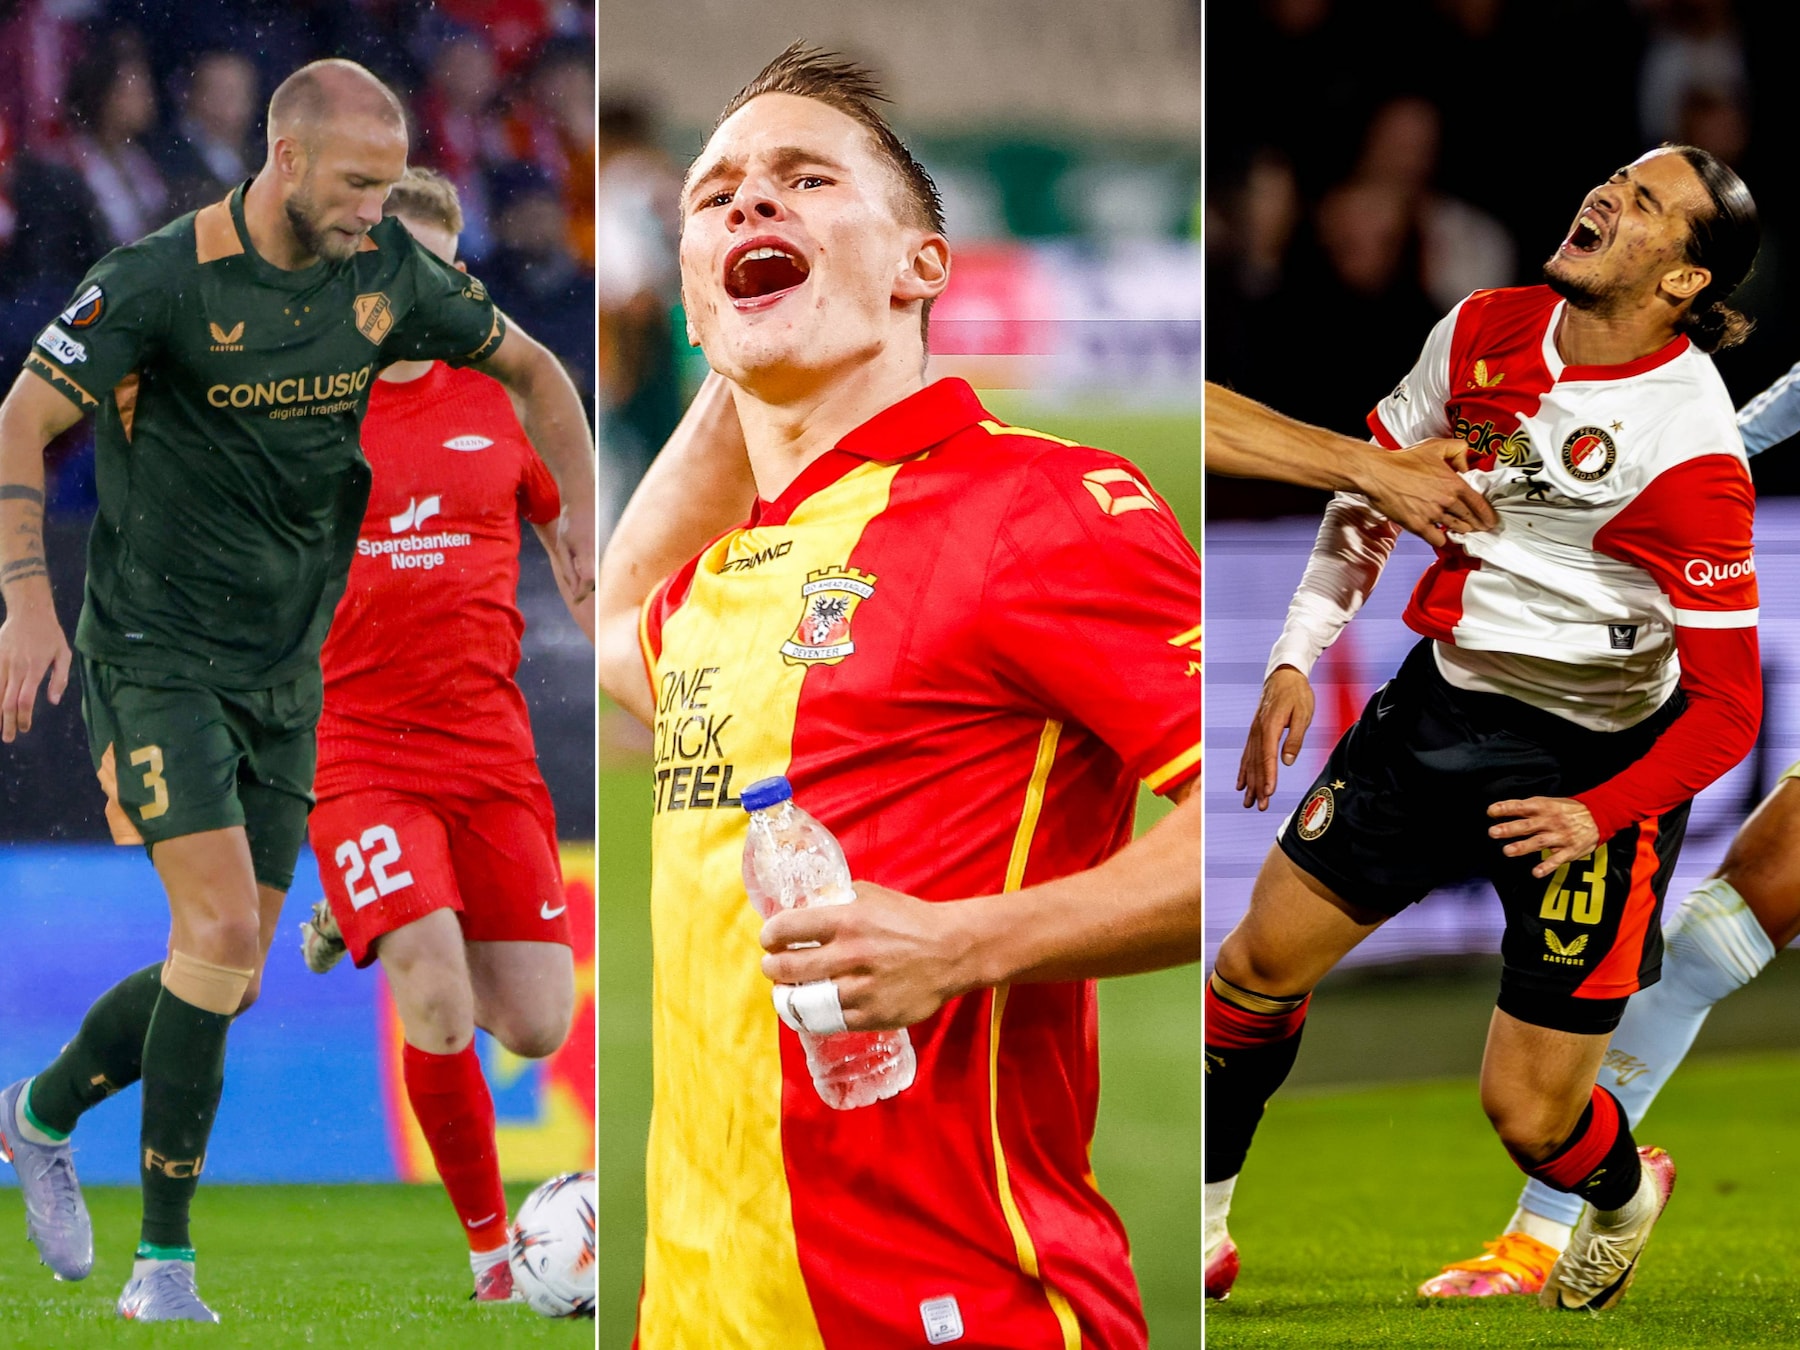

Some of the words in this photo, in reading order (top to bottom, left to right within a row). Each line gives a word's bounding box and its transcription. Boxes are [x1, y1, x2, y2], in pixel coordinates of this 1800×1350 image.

[207, 362, 373, 408] CONCLUSIO
[269, 406, 308, 420] digital
[454, 439, 484, 448] BRANN
[357, 532, 471, 557] Sparebanken
[391, 552, 444, 569] Norge
[792, 647, 839, 658] DEVENTER
[659, 667, 720, 715] ONE
[654, 714, 733, 764] CLICK
[129, 744, 169, 821] 3
[653, 765, 742, 815] TEEL
[335, 824, 415, 912] 22
[1539, 842, 1608, 925] 23
[1543, 954, 1585, 966] CASTORE
